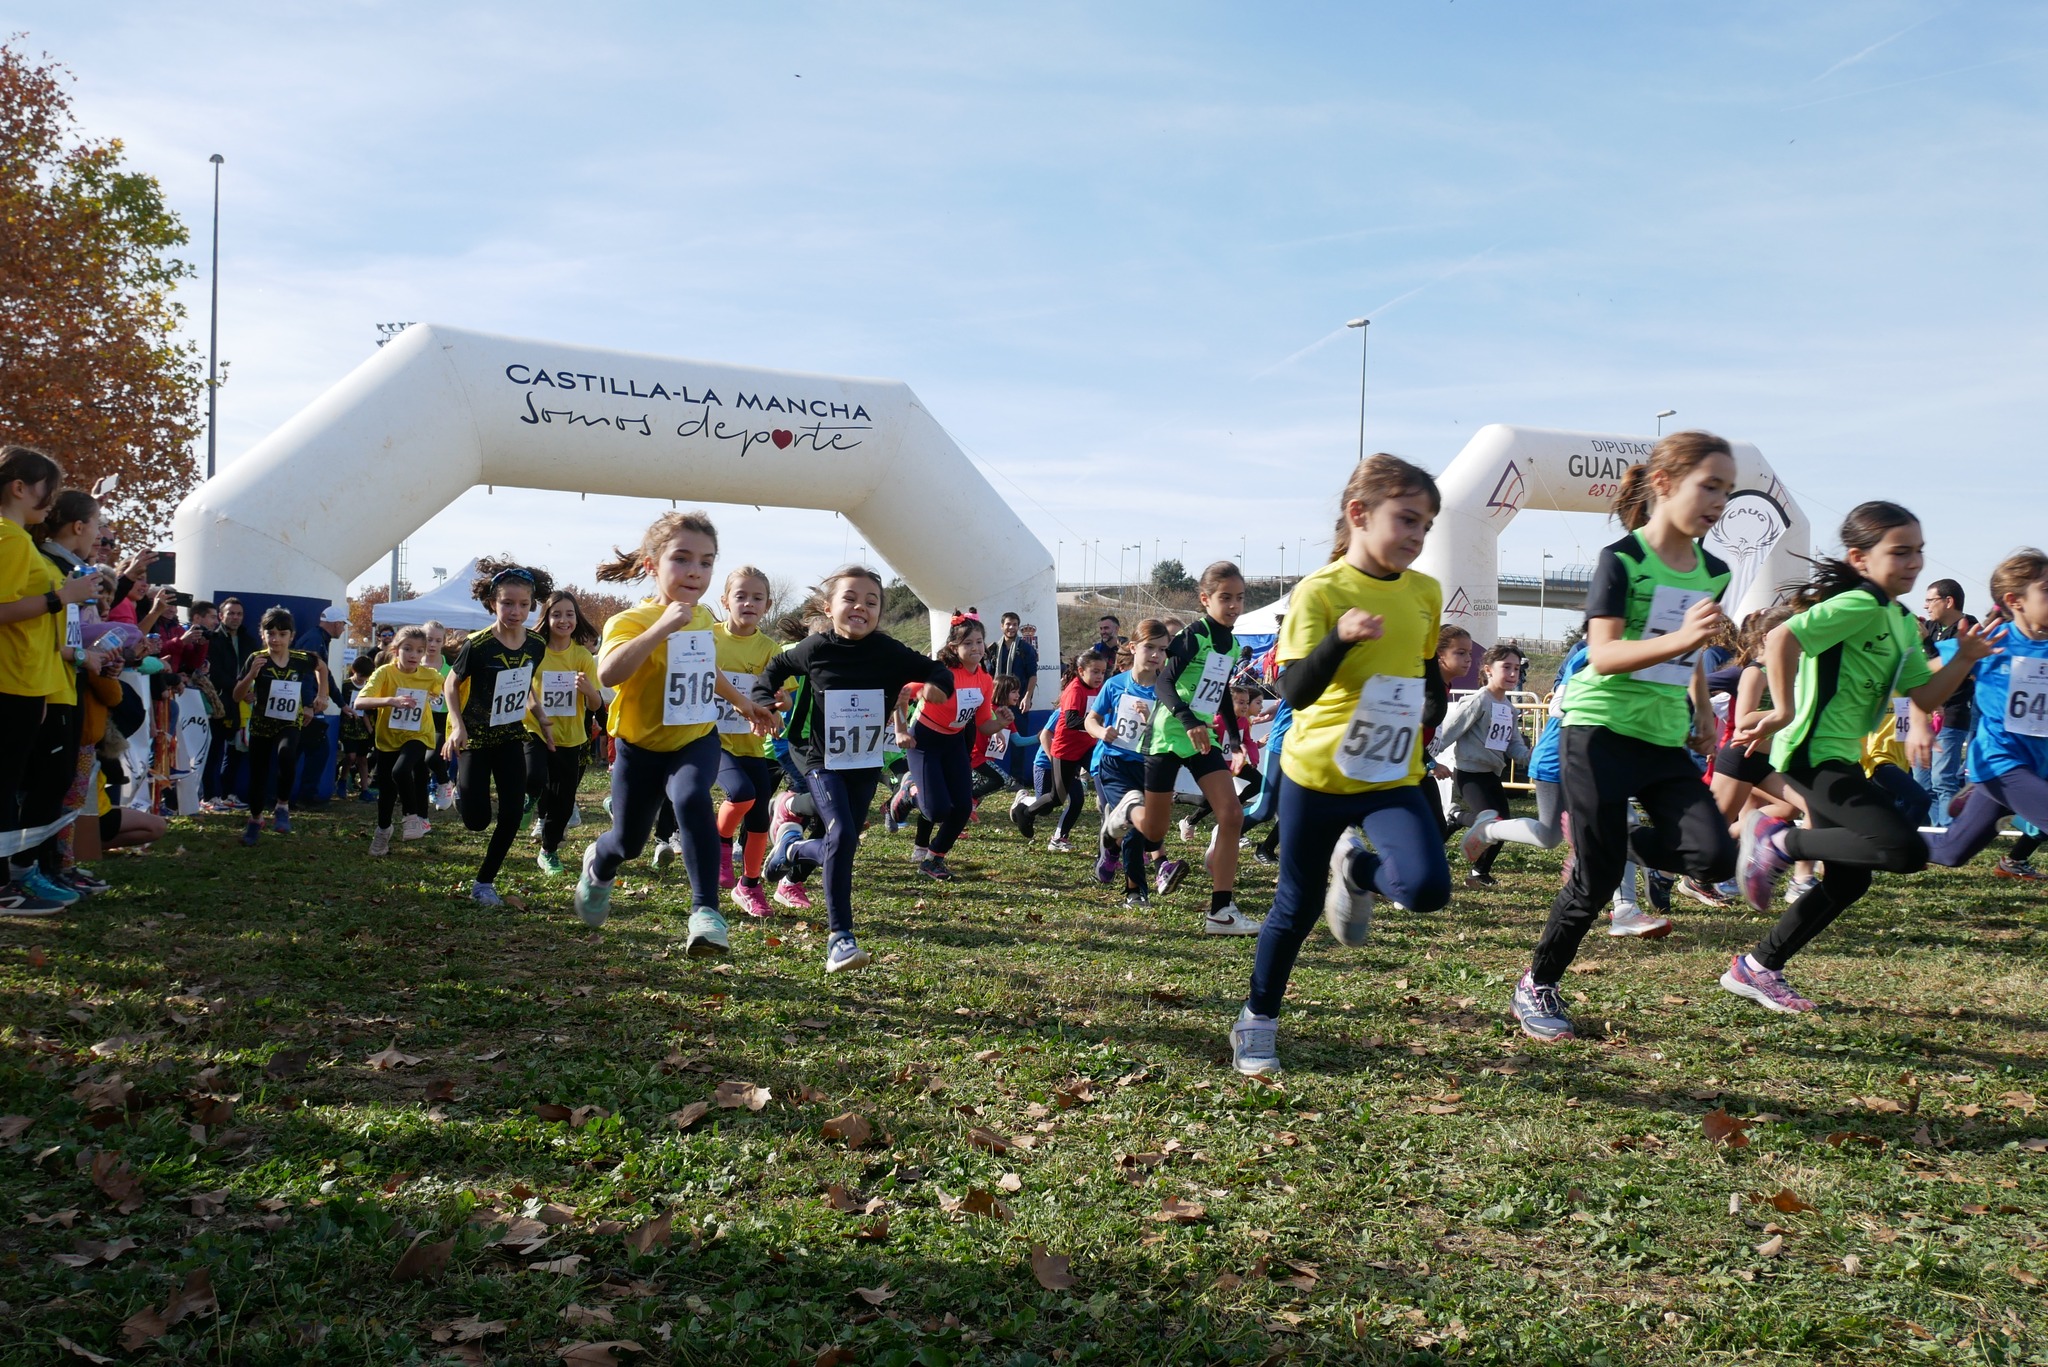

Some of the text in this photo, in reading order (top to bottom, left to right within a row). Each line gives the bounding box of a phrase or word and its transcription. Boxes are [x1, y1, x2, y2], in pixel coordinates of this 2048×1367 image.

[506, 364, 872, 422] CASTILLA-LA MANCHA
[1592, 440, 1655, 456] DIPUTAC
[1569, 455, 1642, 479] GUAD
[1728, 508, 1767, 522] CAUG
[669, 671, 715, 706] 516
[1198, 677, 1225, 703] 725
[269, 697, 296, 713] 180
[495, 690, 526, 715] 182
[544, 691, 573, 708] 521
[714, 697, 747, 721] 52
[2010, 690, 2048, 720] 64
[392, 706, 422, 722] 519
[957, 707, 977, 722] 80
[1896, 716, 1910, 733] 46
[829, 725, 881, 754] 517
[883, 732, 897, 746] 72
[1344, 719, 1413, 764] 520
[1490, 723, 1512, 742] 812
